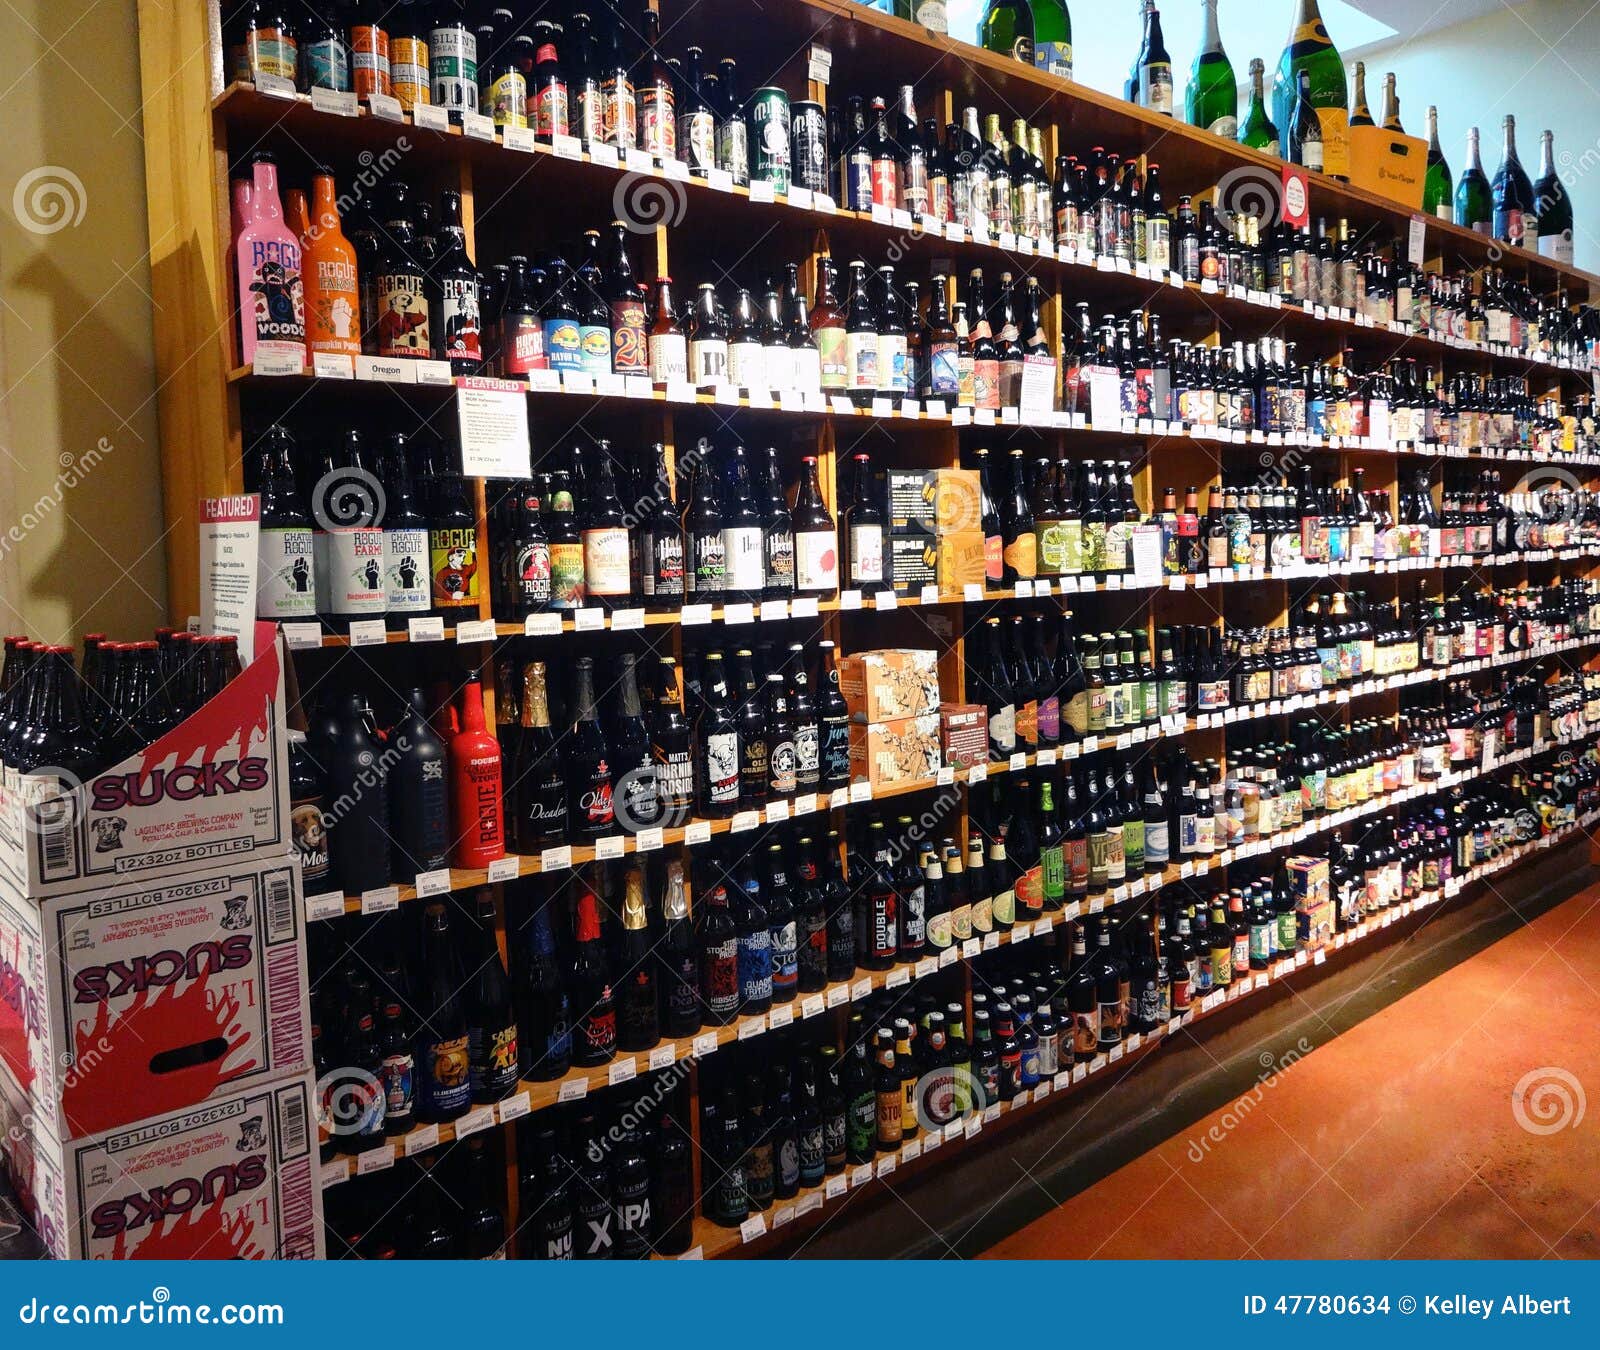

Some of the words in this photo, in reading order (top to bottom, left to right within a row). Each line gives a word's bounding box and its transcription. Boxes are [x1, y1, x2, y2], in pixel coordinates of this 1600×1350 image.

[317, 262, 356, 281] ROGUE
[377, 275, 424, 298] ROGUE
[372, 364, 401, 376] Oregon
[465, 377, 519, 391] FEATURED
[206, 496, 254, 518] FEATURED
[391, 533, 423, 541] CHATOE
[391, 541, 423, 553] ROGUE
[431, 529, 475, 548] ROGUE
[91, 757, 268, 812] SUCKS
[134, 822, 175, 837] LAGUNITAS
[177, 817, 209, 829] BREWING
[211, 812, 243, 824] COMPANY
[186, 839, 251, 858] BOTTLES
[93, 892, 163, 914] BOTTLES
[139, 919, 173, 934] BREWING
[174, 912, 214, 928] LAGUNITAS
[876, 900, 886, 950] DOUBLE
[102, 926, 137, 943] COMPANY
[74, 935, 252, 1004] SUCKS
[267, 943, 301, 1011] UNLIMITED
[271, 1010, 304, 1069] RELEASE
[110, 1121, 180, 1149] BOTTLES
[91, 1154, 267, 1239] SUCKS
[618, 1197, 650, 1231] IPA
